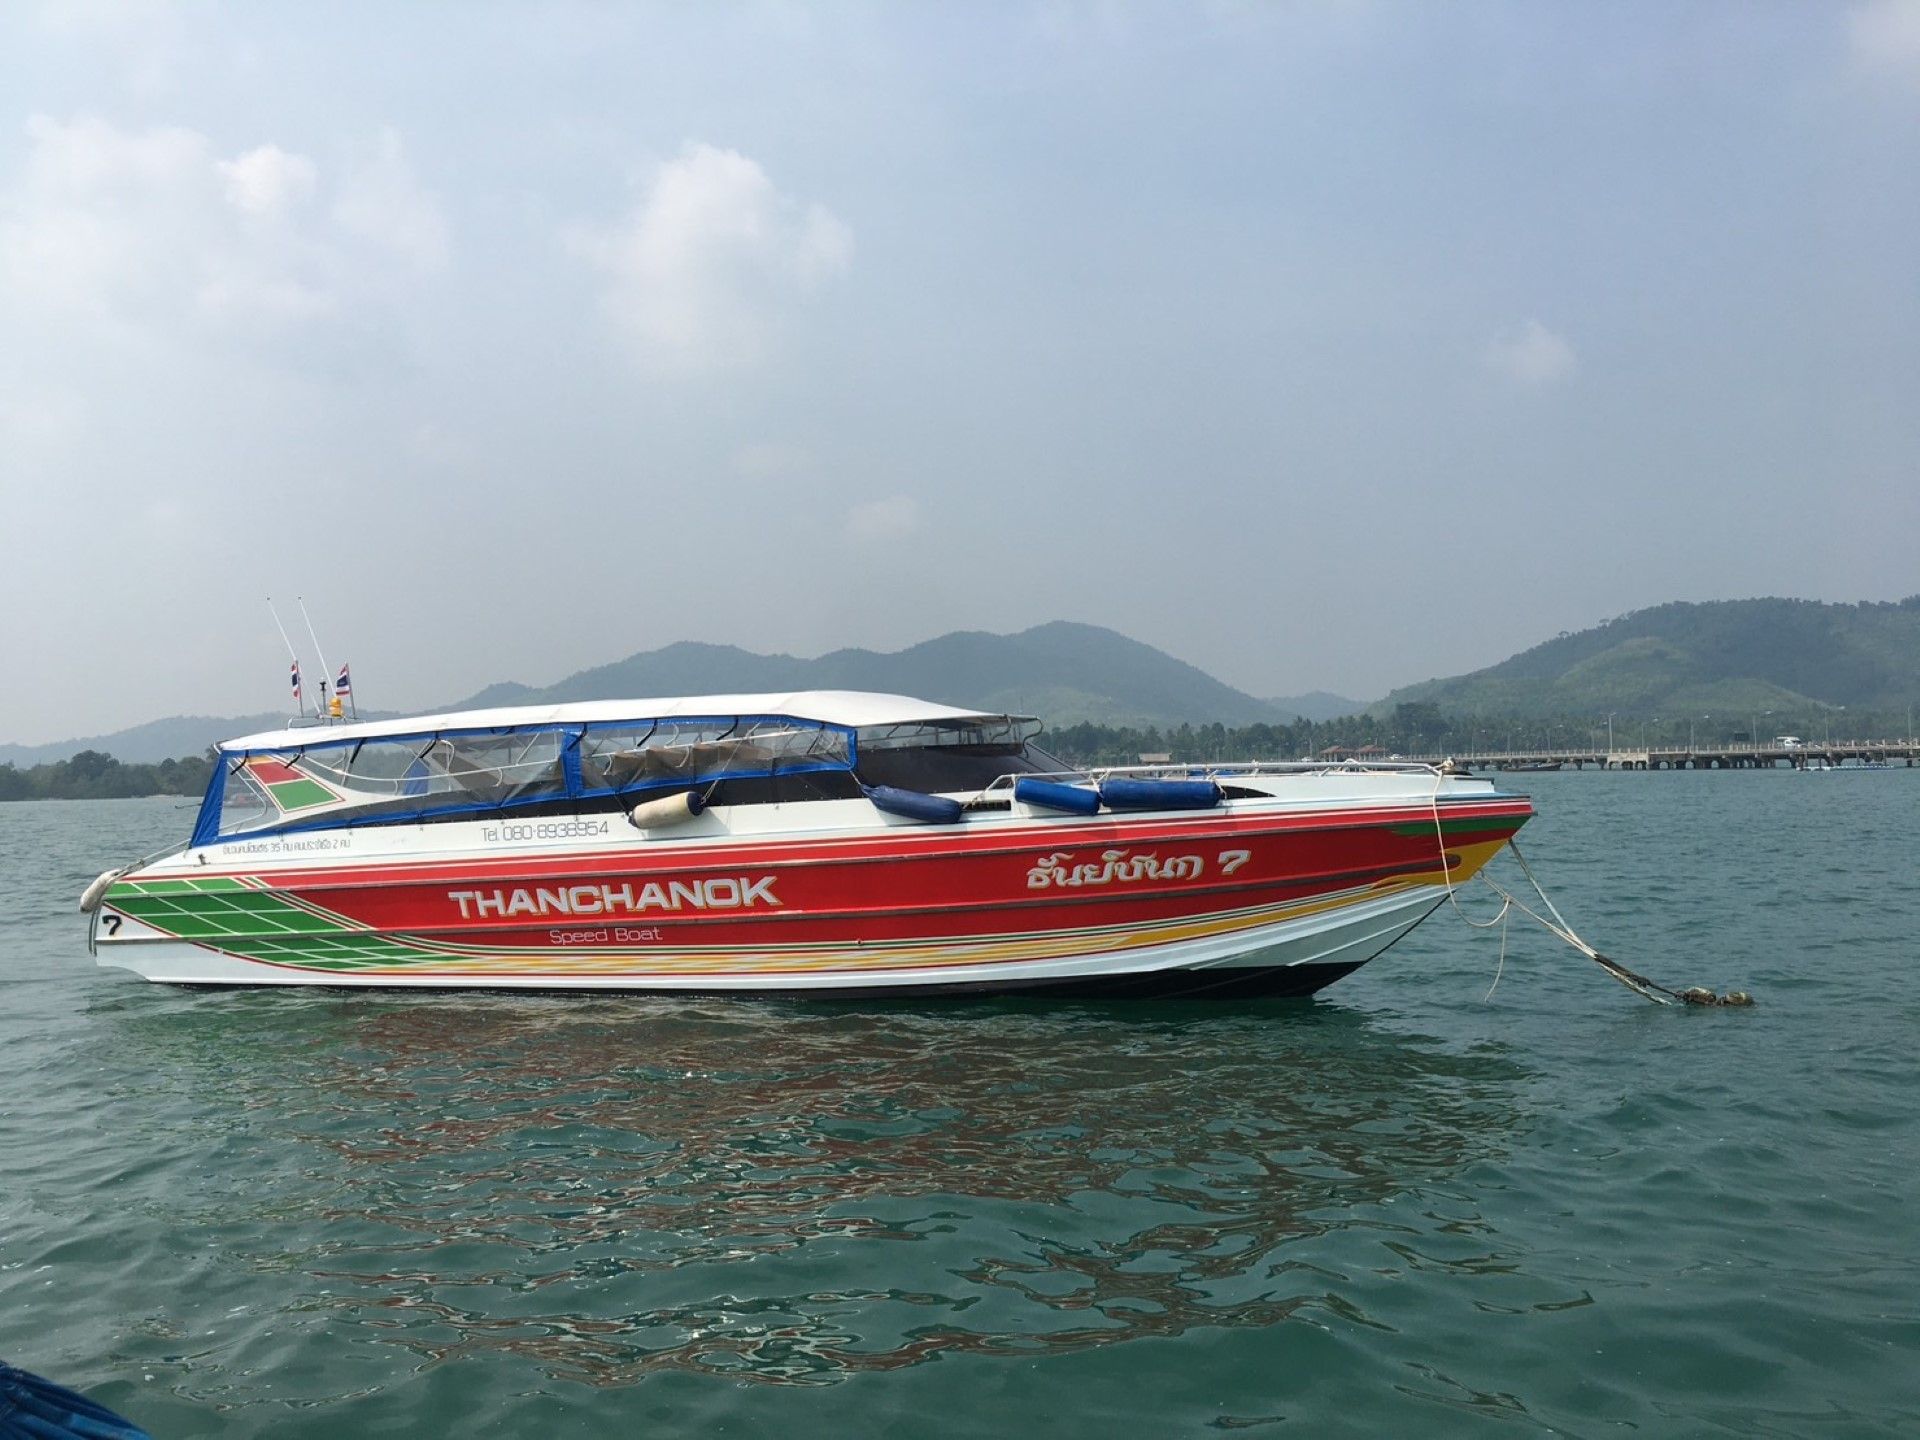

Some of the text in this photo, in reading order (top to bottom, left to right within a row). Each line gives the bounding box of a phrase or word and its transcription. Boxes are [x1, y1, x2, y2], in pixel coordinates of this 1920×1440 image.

[1217, 850, 1252, 876] 7
[448, 876, 783, 919] THANCHANOK
[102, 915, 122, 935] 7
[550, 926, 664, 945] Speed Boat
